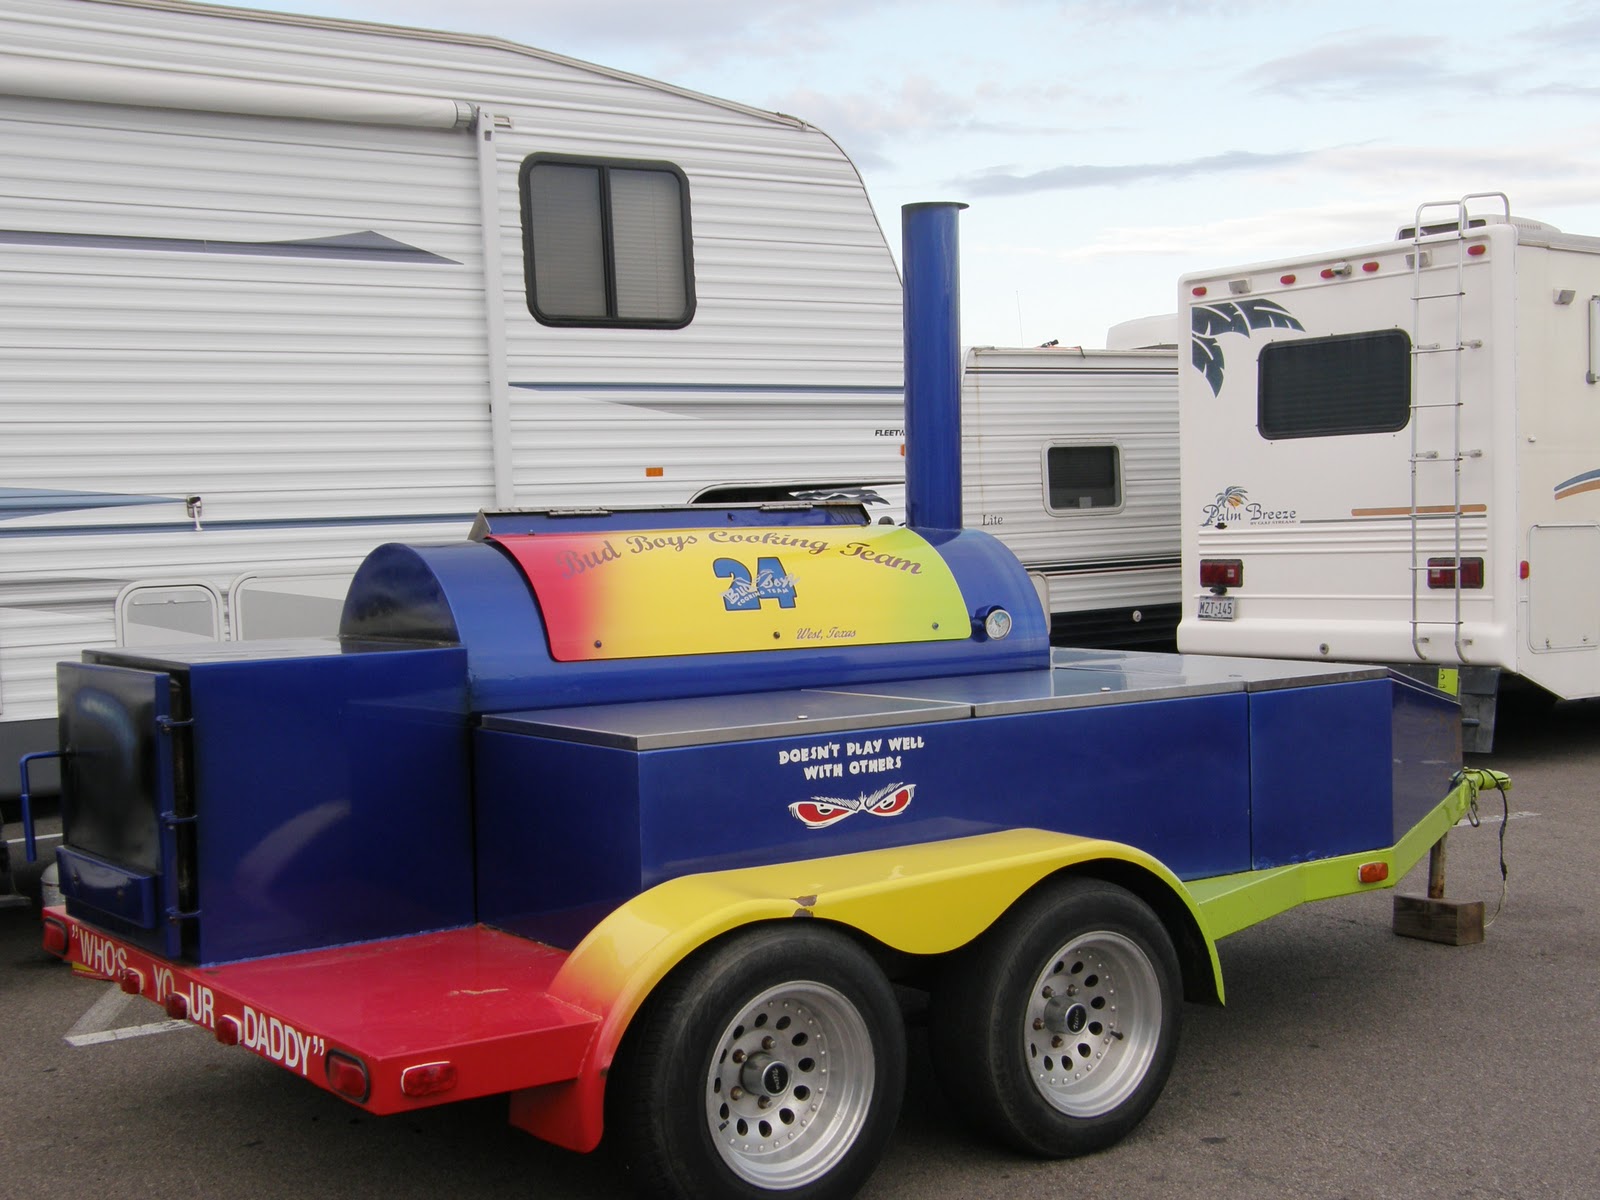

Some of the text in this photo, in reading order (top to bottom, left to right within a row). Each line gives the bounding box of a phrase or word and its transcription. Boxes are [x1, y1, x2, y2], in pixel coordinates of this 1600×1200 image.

[982, 514, 1003, 526] Lite
[1200, 503, 1297, 526] Palm Breeze
[557, 531, 923, 580] Bud Boys Cooking Team
[712, 556, 798, 612] 24
[796, 626, 857, 640] West, Texas
[779, 736, 925, 765] DOESN'T PLAY WELL
[803, 756, 902, 780] WITH OTHERS
